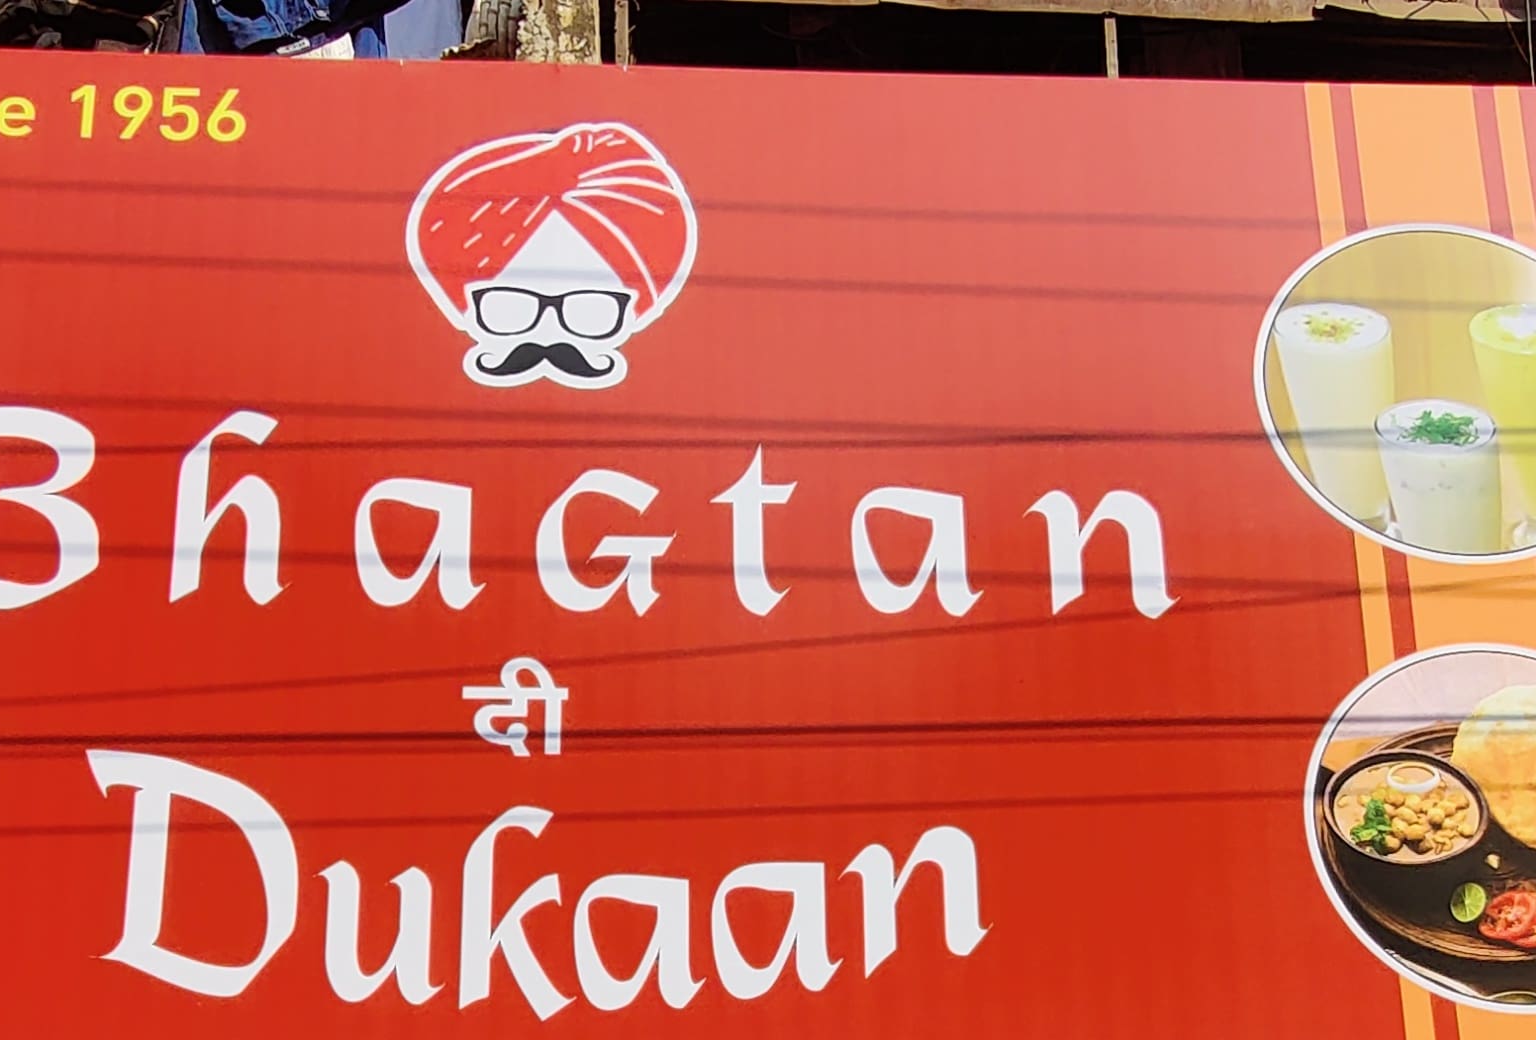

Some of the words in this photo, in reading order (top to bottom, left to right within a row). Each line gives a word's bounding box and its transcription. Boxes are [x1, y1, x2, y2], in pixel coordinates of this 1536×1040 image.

[70, 83, 248, 143] 1956
[462, 656, 569, 757] दी
[85, 748, 993, 1022] Dukaan
